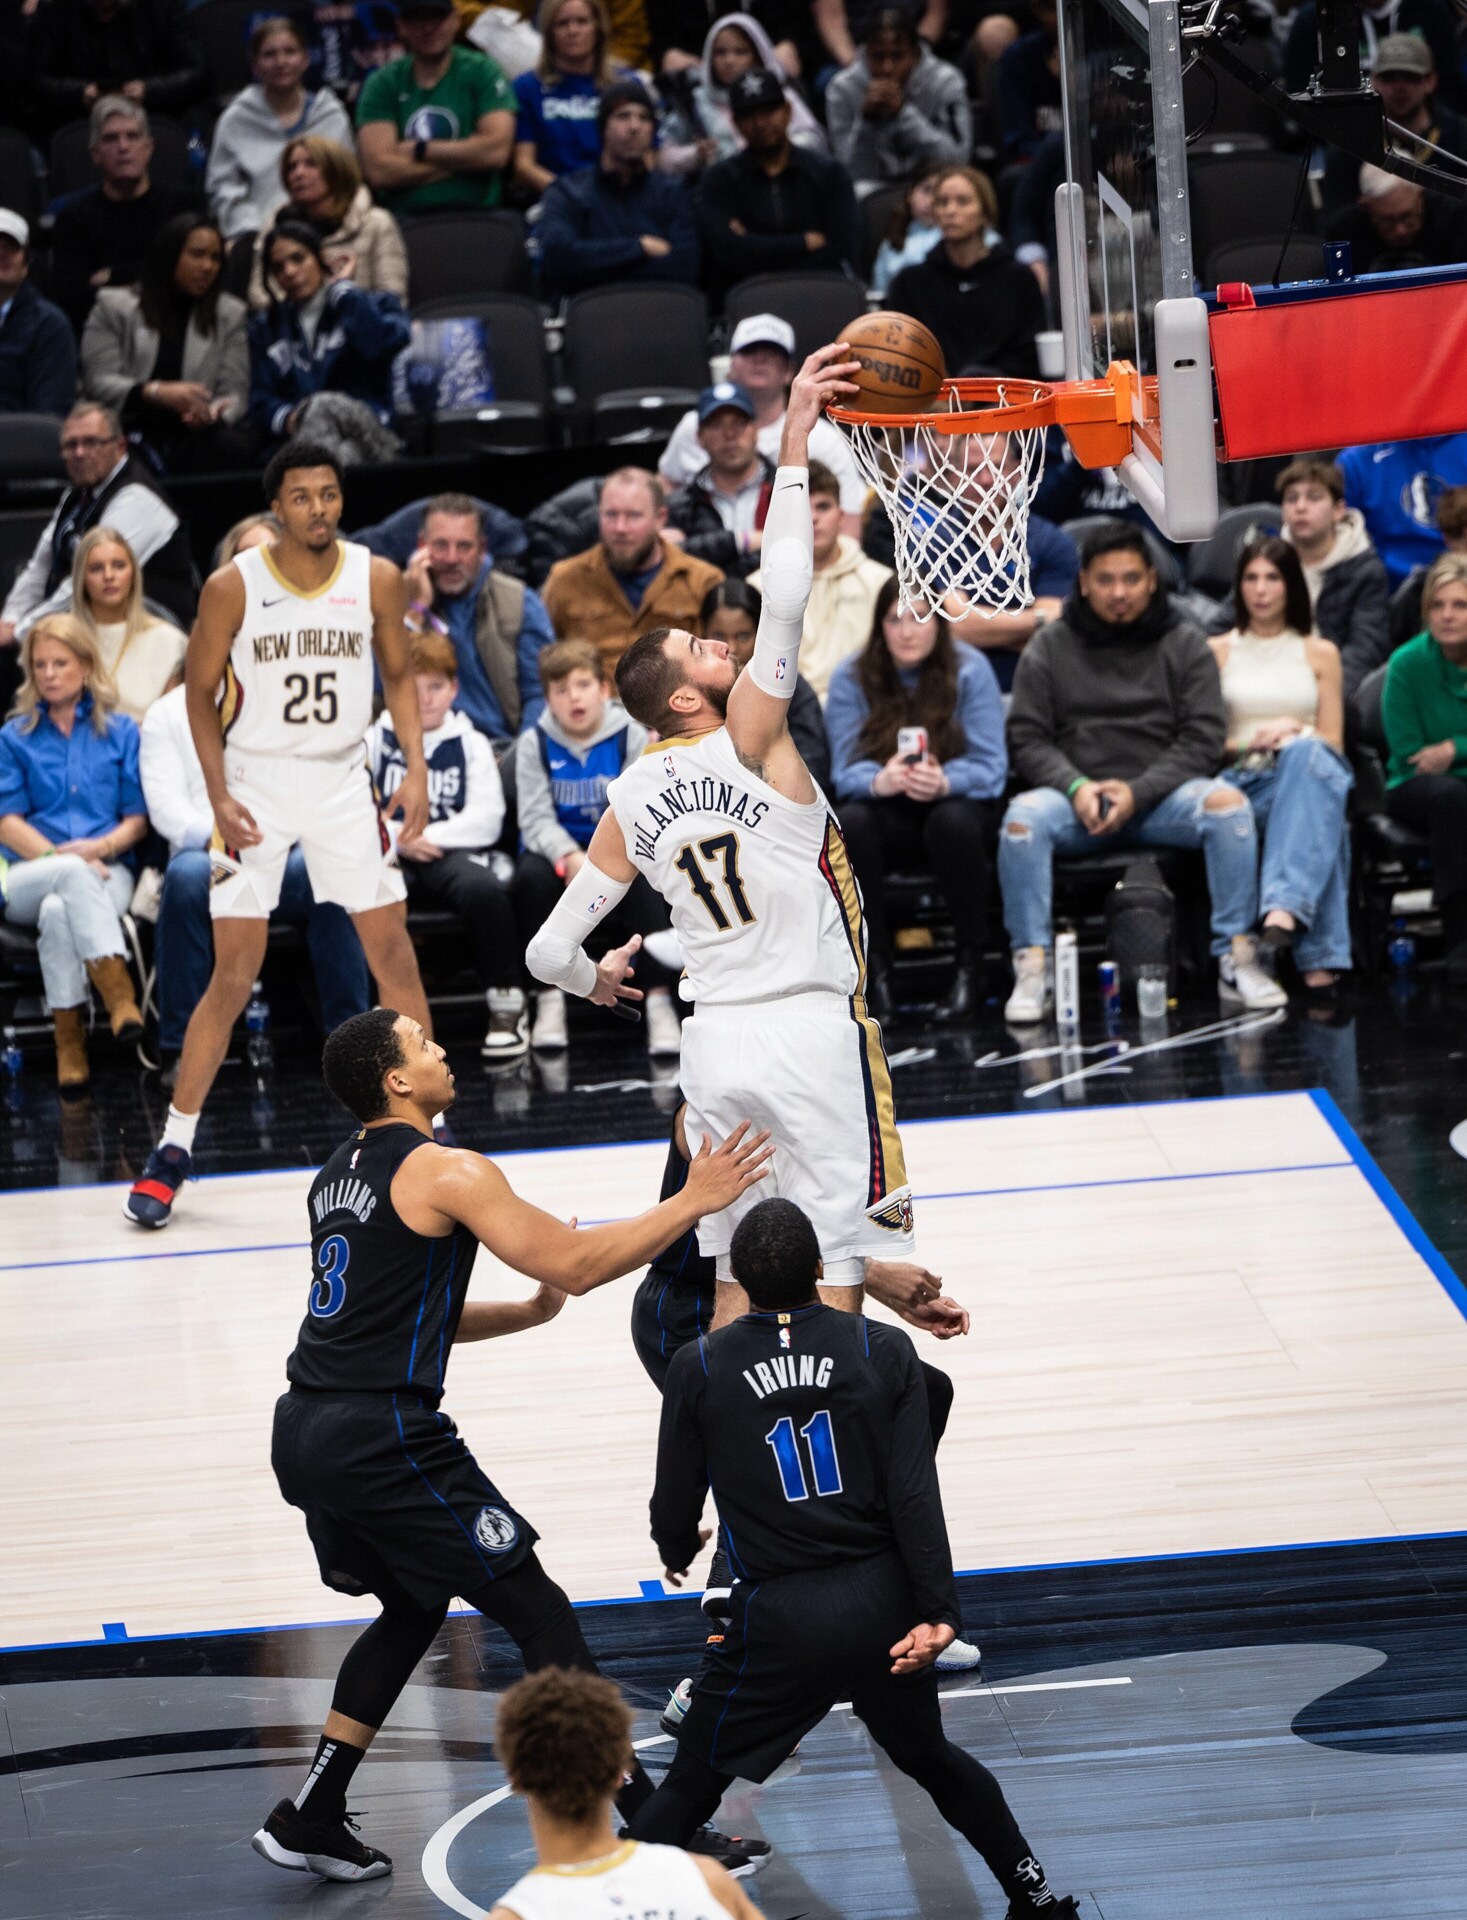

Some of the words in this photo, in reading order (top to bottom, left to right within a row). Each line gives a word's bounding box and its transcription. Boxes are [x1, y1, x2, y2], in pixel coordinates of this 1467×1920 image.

[253, 632, 290, 664] NEW
[298, 628, 363, 659] ORLEANS
[283, 670, 338, 724] 25
[635, 776, 770, 862] VALANČIŪNAS
[674, 830, 758, 932] 17
[313, 1178, 377, 1223] WILLIAMS
[309, 1234, 350, 1318] 3
[742, 1354, 834, 1400] IRVING
[765, 1409, 843, 1502] 11
